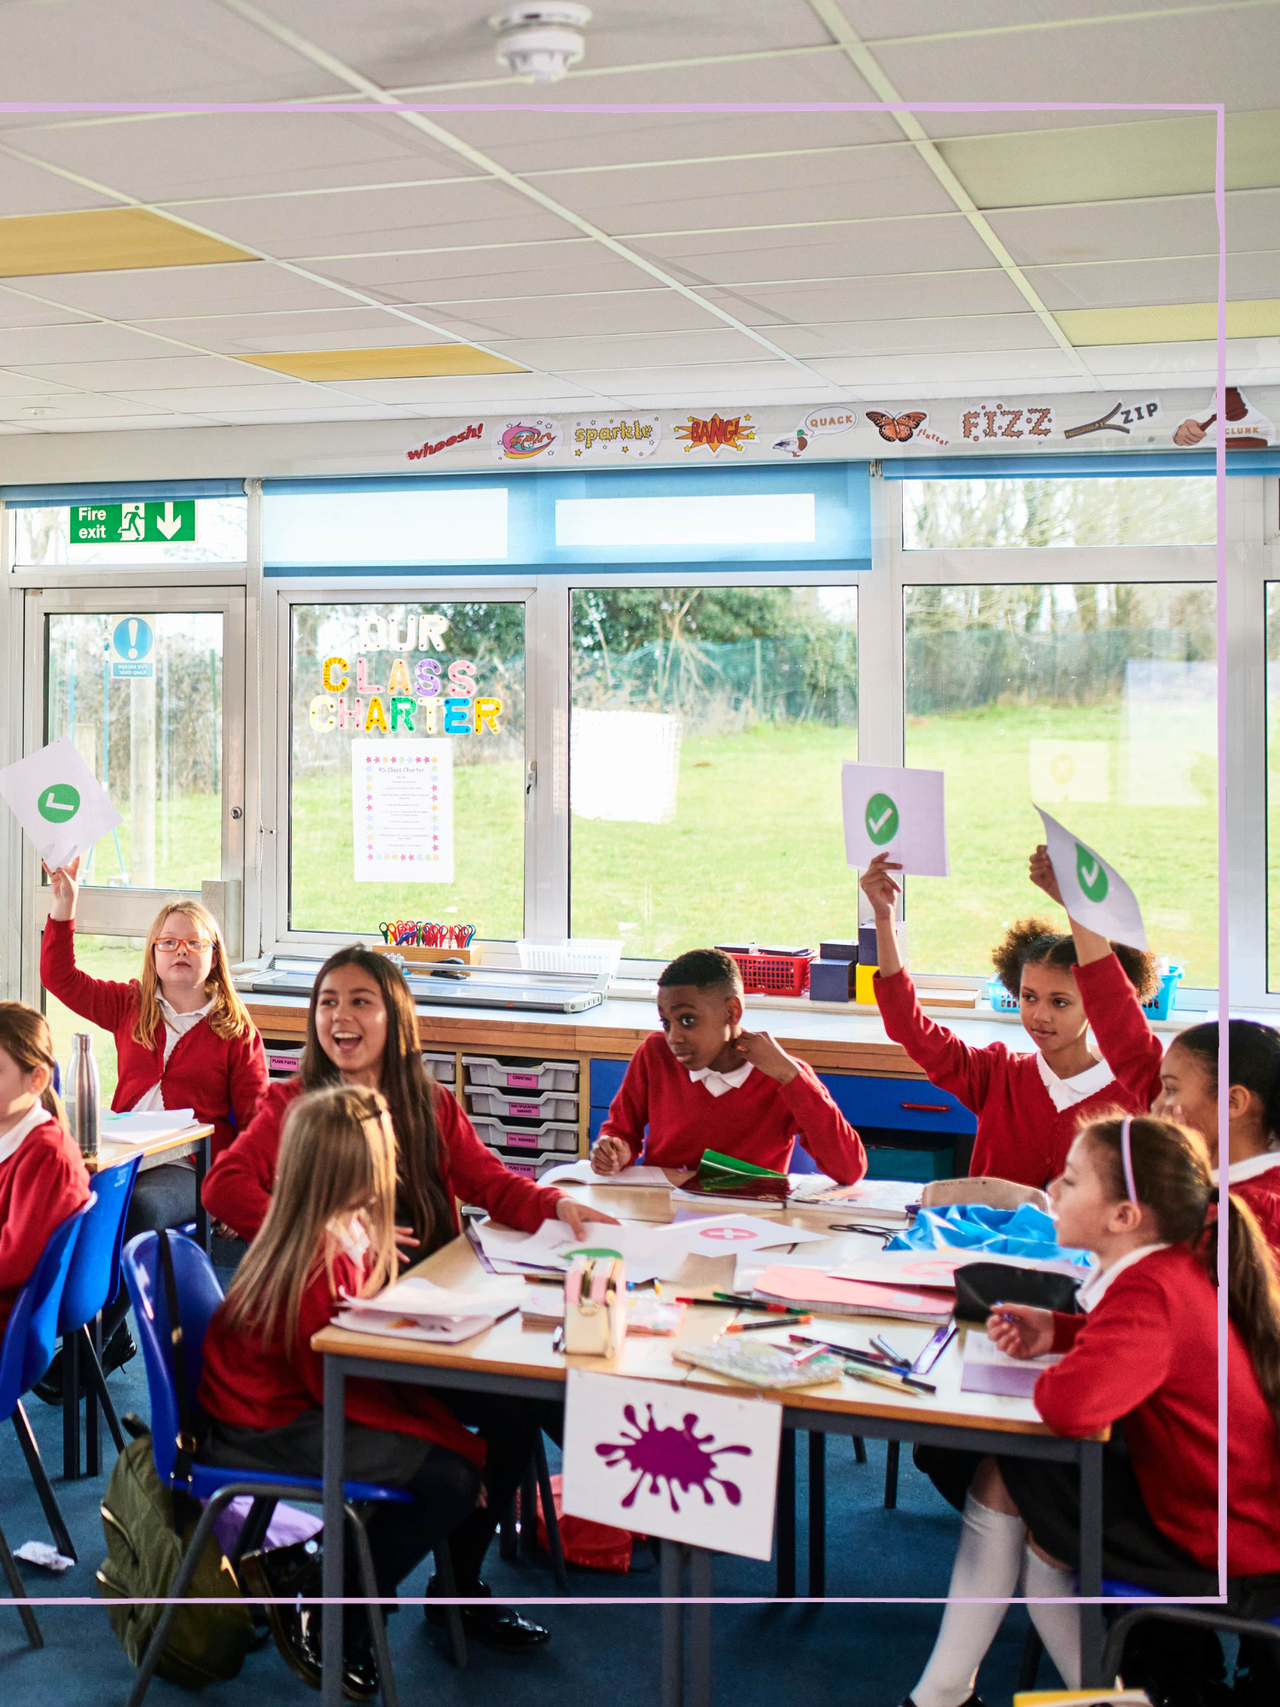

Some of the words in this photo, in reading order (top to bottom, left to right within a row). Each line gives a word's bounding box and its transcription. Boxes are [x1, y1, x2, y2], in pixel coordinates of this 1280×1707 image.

[810, 414, 853, 427] QUACK
[963, 408, 1052, 438] FIZZ
[1121, 403, 1158, 424] ZIP
[407, 423, 484, 460] whoosh!
[509, 432, 553, 450] spin
[575, 420, 653, 448] sparkle
[691, 419, 740, 443] BANG!
[917, 428, 950, 446] flutter
[1225, 427, 1260, 435] CLUNK
[79, 507, 107, 521] Fire
[79, 524, 107, 539] exit
[358, 614, 449, 652] OUR
[323, 656, 477, 698] CLASS
[309, 695, 502, 735] CHARTER
